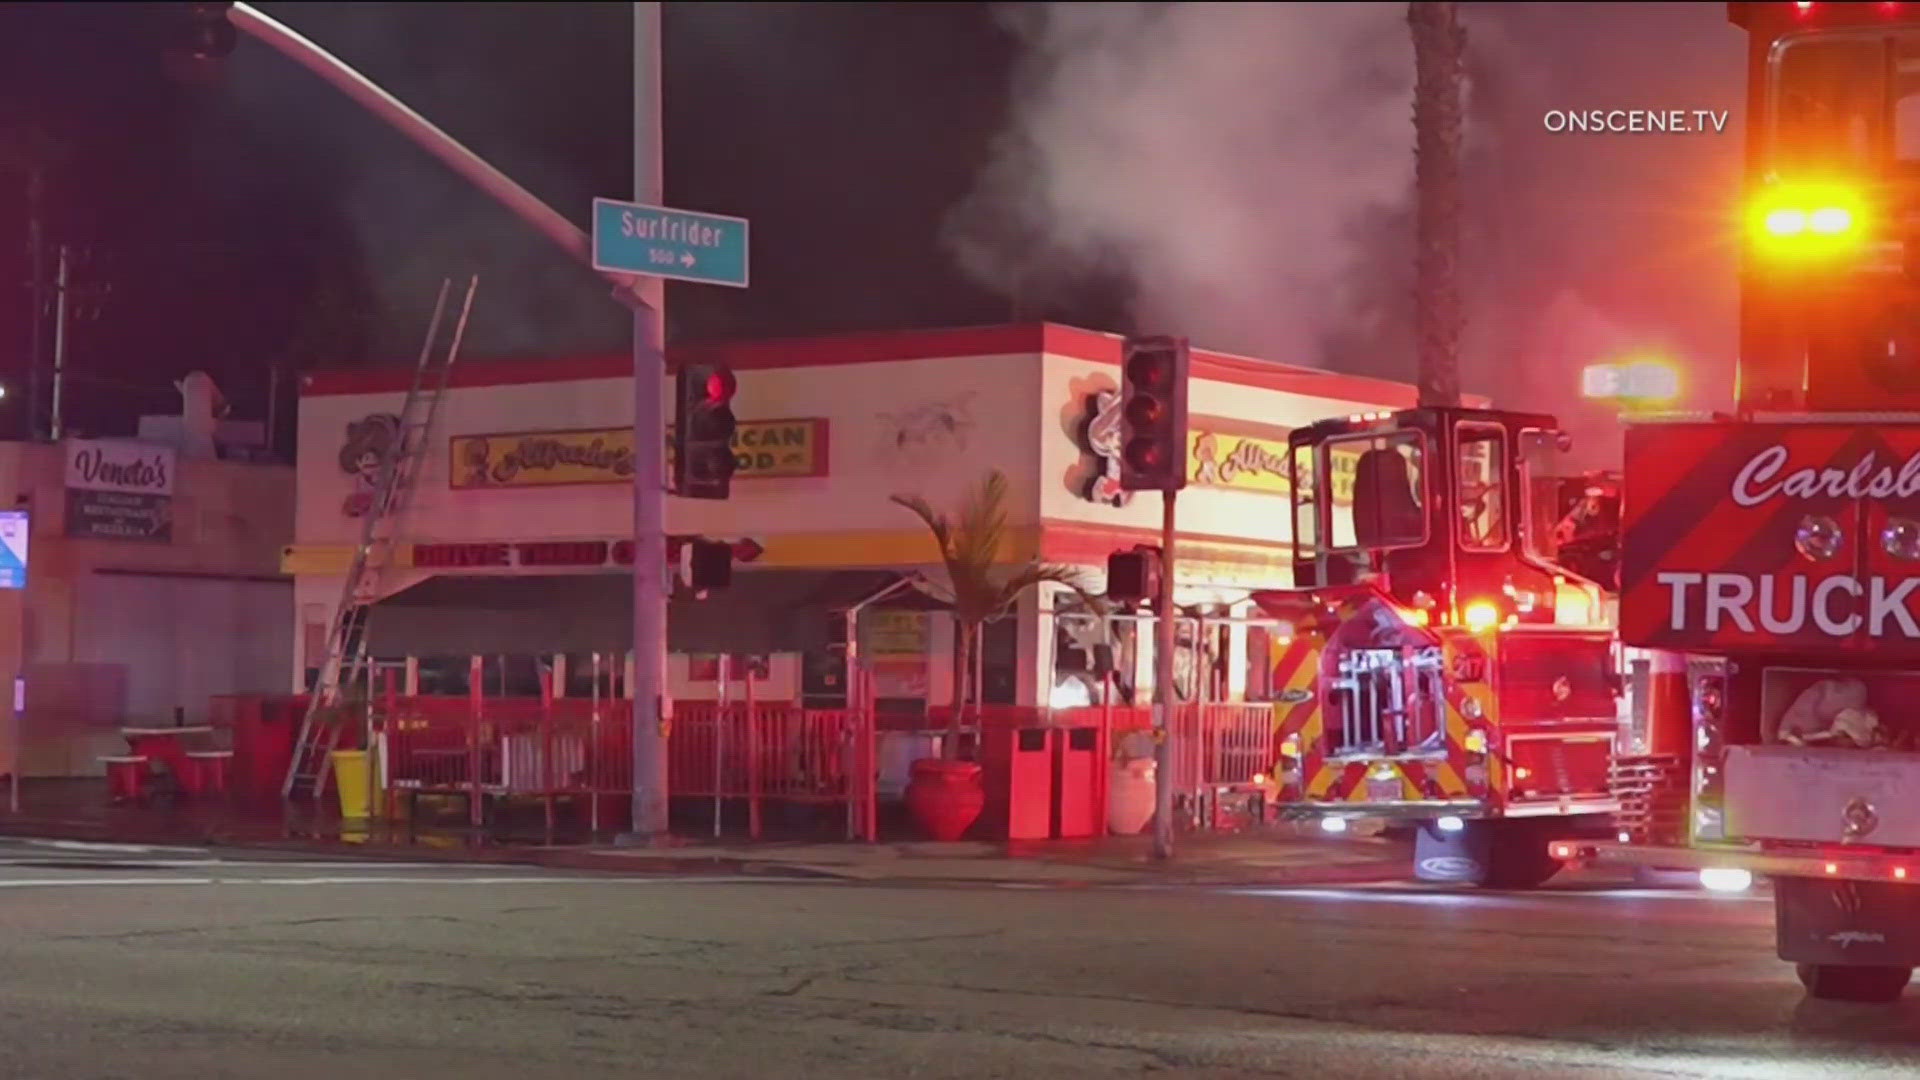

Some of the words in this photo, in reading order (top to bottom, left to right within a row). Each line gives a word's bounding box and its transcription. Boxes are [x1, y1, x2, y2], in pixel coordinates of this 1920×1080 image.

[621, 210, 723, 248] Surfrider
[75, 448, 166, 488] Veneto's
[1731, 445, 1920, 507] Carlsb
[1657, 571, 1920, 638] TRUCK
